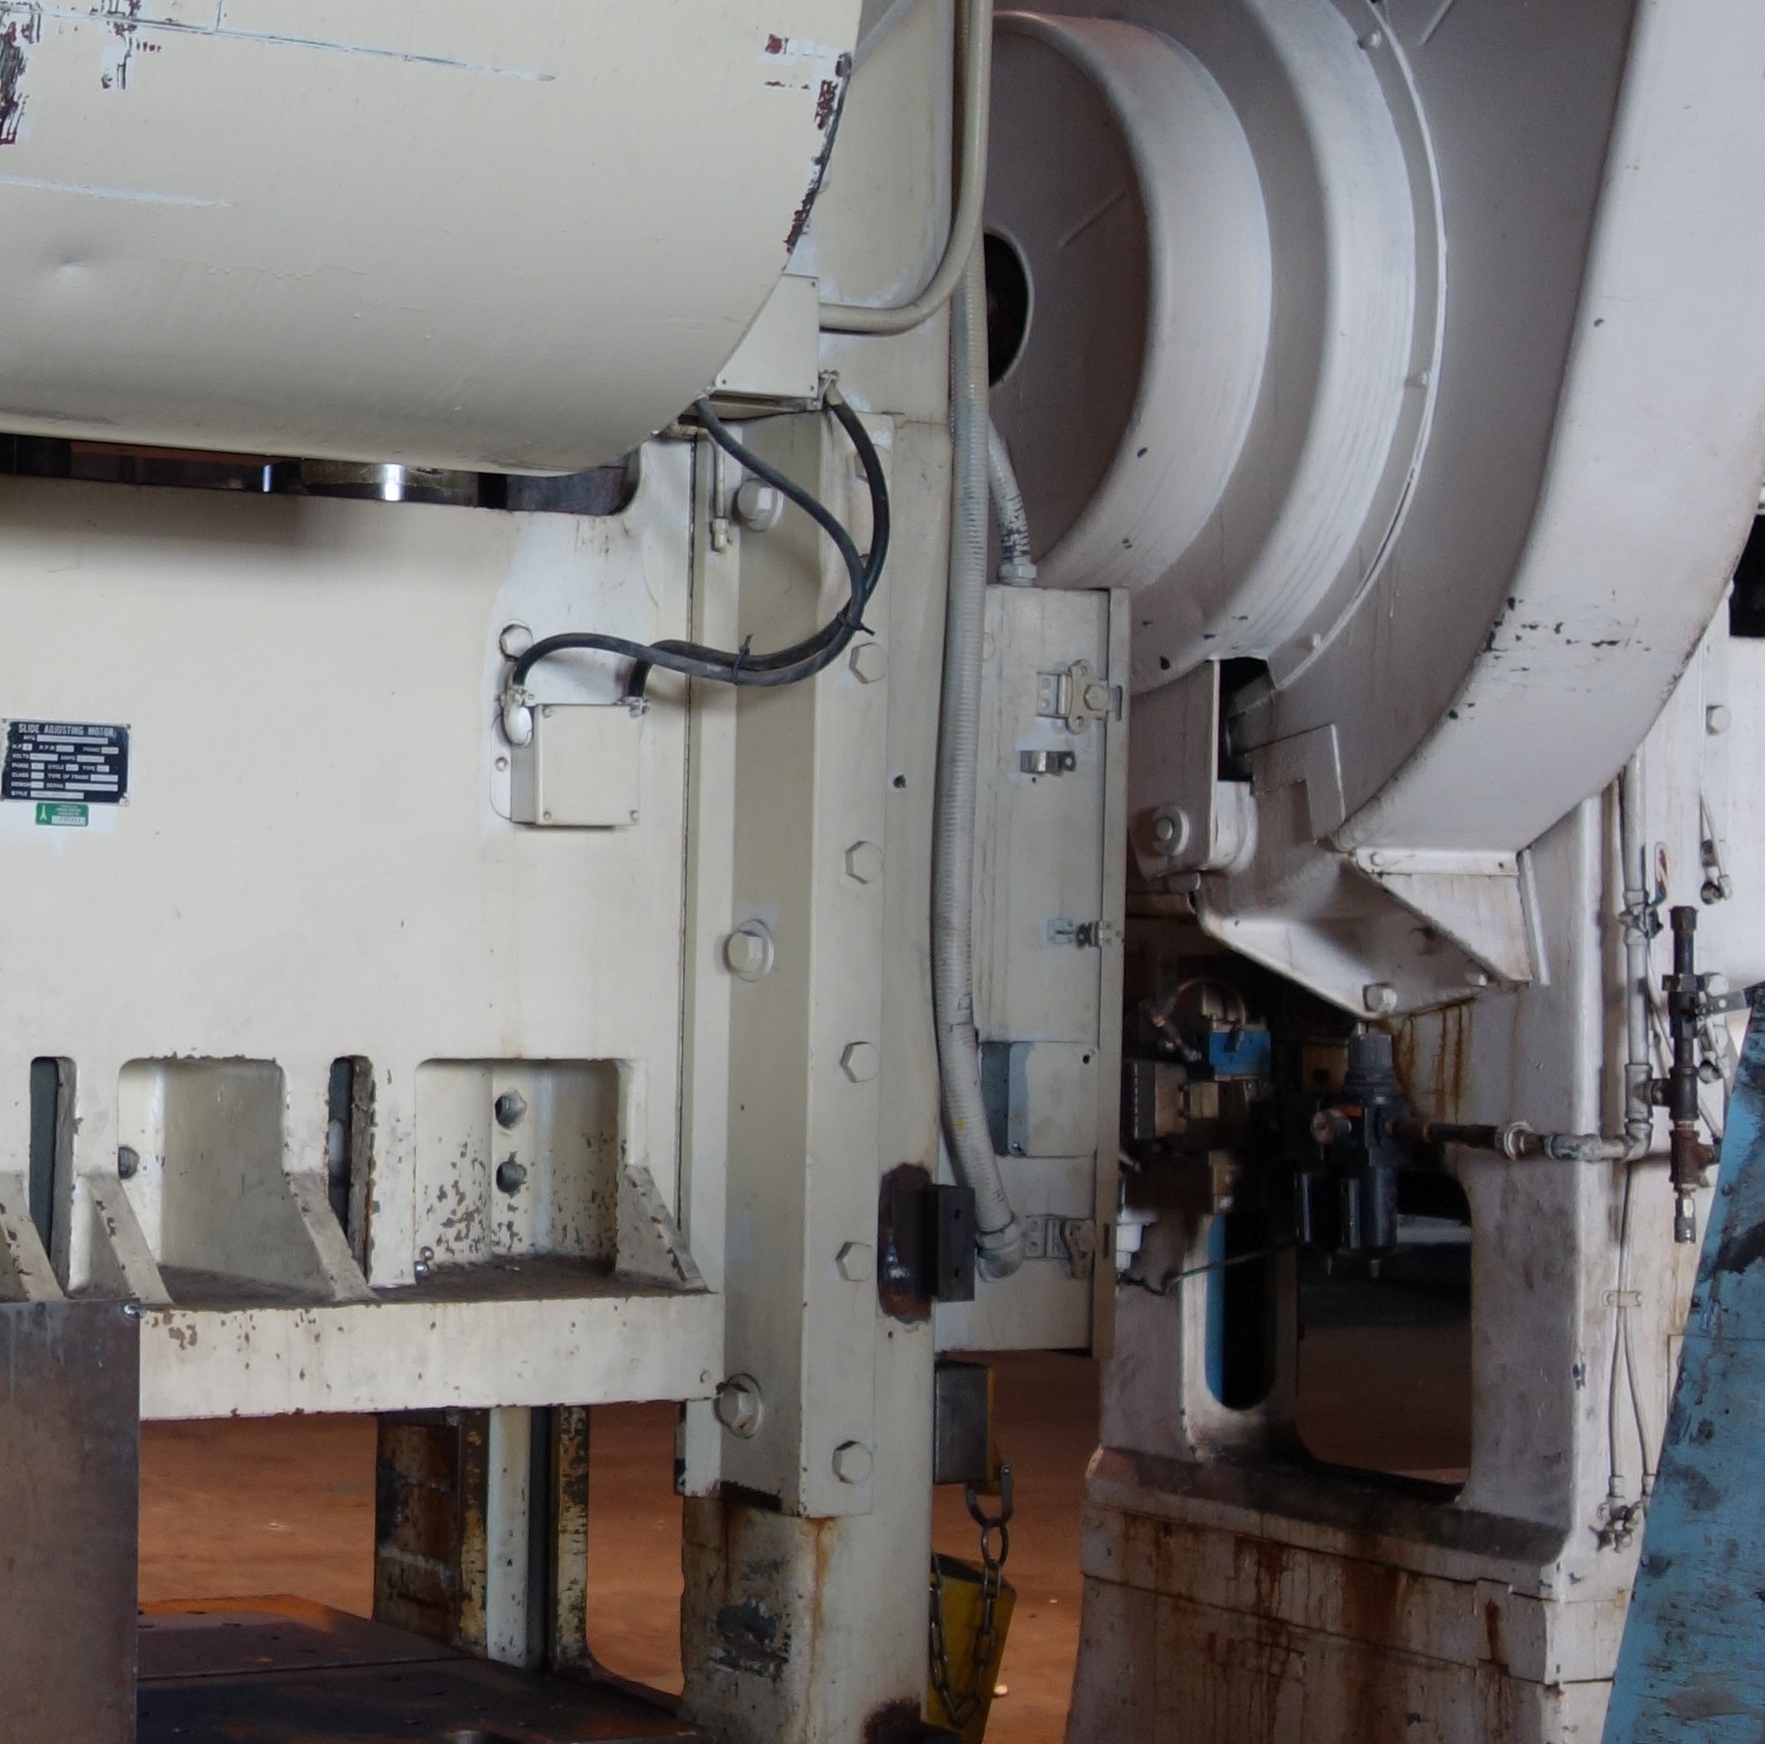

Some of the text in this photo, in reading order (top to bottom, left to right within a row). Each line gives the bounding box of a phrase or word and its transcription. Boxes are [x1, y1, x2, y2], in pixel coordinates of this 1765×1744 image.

[18, 723, 114, 737] SLIDE ADJUSTING MOTOR
